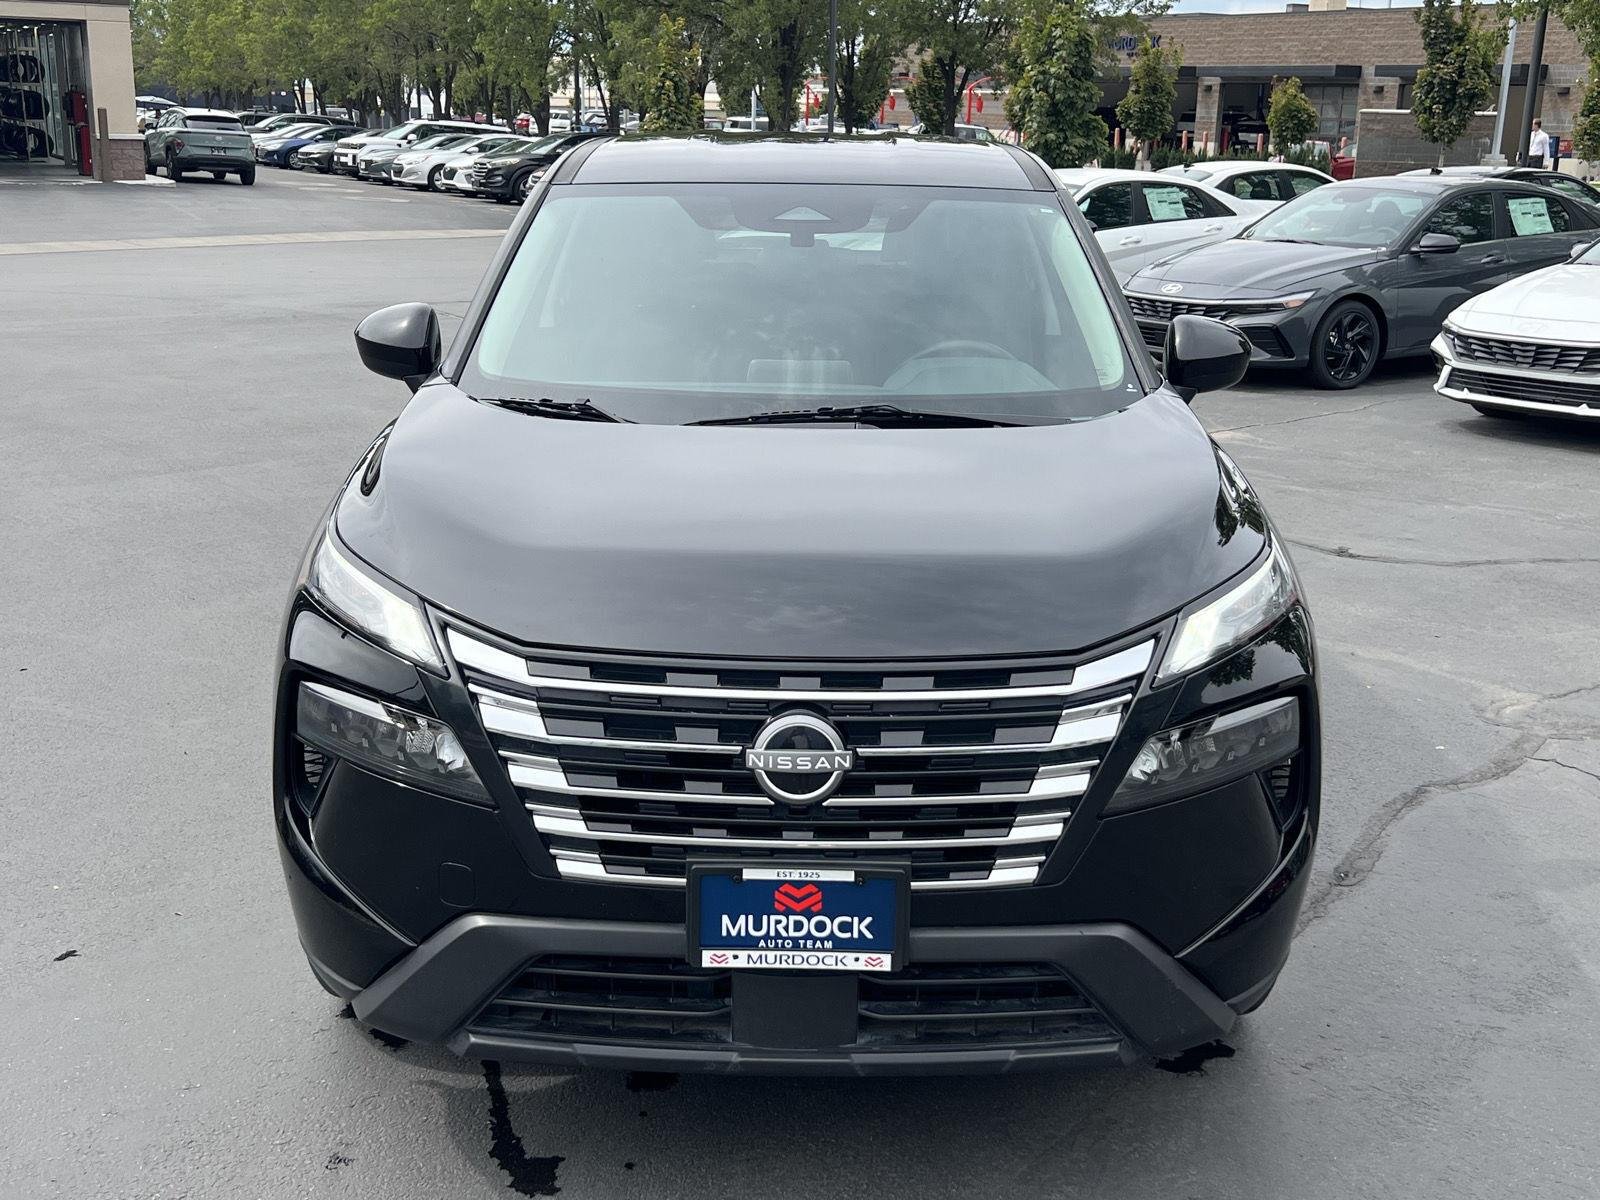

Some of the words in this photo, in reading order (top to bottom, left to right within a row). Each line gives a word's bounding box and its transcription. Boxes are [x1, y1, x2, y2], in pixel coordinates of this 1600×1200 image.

[748, 754, 850, 769] NISSAN
[798, 871, 821, 879] 1925
[721, 914, 874, 939] MURDOCK
[758, 939, 793, 949] AUTO
[798, 940, 833, 949] TEAM
[747, 953, 848, 967] MURDOCK
